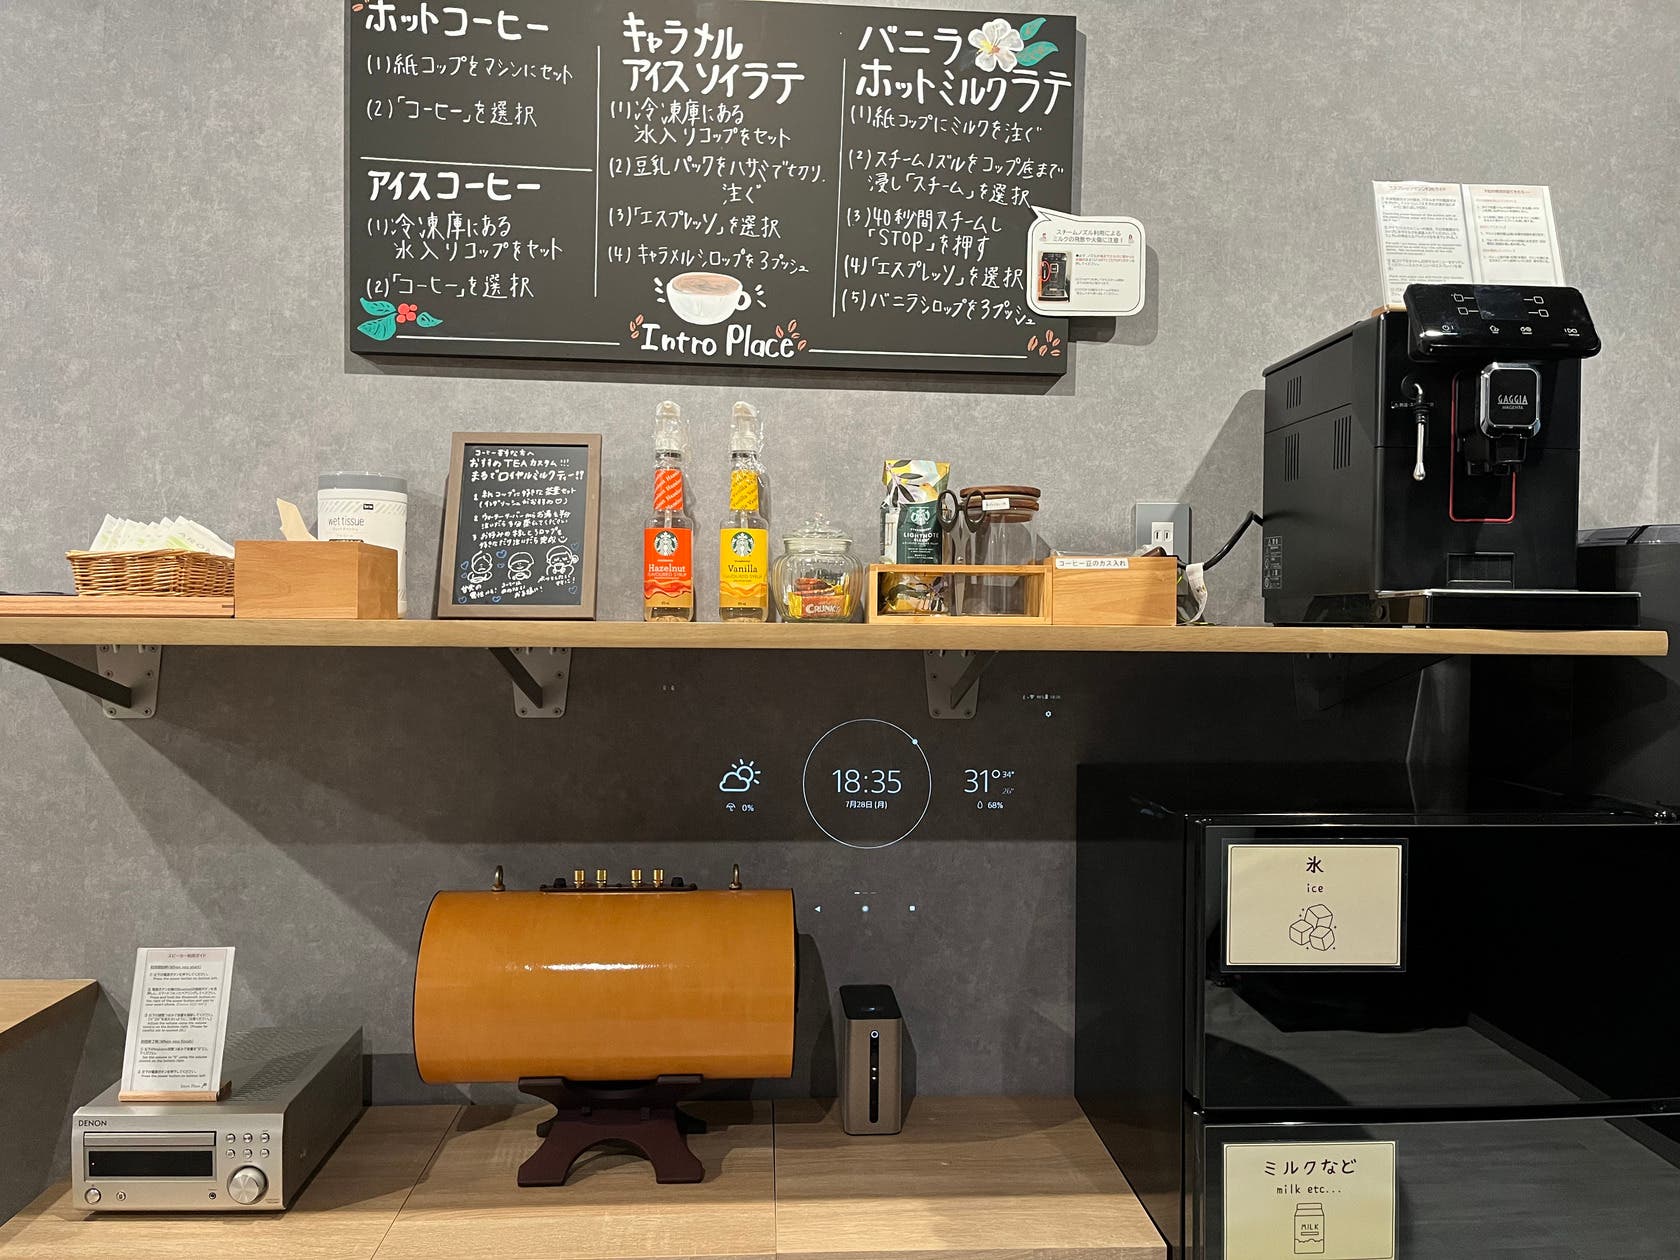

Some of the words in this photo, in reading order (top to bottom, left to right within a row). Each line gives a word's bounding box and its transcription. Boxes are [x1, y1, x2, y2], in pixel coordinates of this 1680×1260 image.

[366, 0, 549, 40] ホットコーヒー
[623, 11, 743, 60] キャラメル
[858, 26, 962, 66] バニラ
[856, 58, 1072, 115] ホットミルクラテ
[366, 95, 537, 127] (2)「コーヒー」を選択
[611, 97, 744, 125] (1)冷凍庫にある
[634, 124, 791, 148] 氷入りコップをセット
[368, 170, 541, 201] アイスコーヒー
[722, 182, 762, 206] 注ぐ
[868, 172, 1031, 208] 浸し「スチーム」を選択
[367, 211, 511, 240] (1)冷凍庫にある
[394, 238, 562, 262] 氷入りコップをセット
[868, 229, 990, 262] 「STOP」を押す
[366, 273, 534, 299] (2)「コーヒー」を選択
[640, 323, 717, 355] Intro
[725, 324, 795, 358] Place
[1497, 394, 1528, 404] GAGGIA
[503, 458, 527, 468] TEA
[329, 517, 340, 526] wet
[341, 516, 365, 526] tissue
[648, 563, 686, 573] Hazelnut
[728, 564, 758, 573] Vanilla
[832, 769, 902, 794] 18:35
[741, 803, 755, 812] 0%
[845, 800, 872, 809] 7月28日
[874, 800, 888, 810] (月)
[987, 801, 1004, 809] 68%
[1306, 856, 1324, 873] 氷
[1307, 883, 1324, 893] ice
[78, 1119, 107, 1127] DENON
[1264, 1159, 1357, 1176] ミルクなど
[1276, 1184, 1301, 1194] milk
[1307, 1185, 1342, 1194] etc...
[1301, 1223, 1319, 1231] MILK
